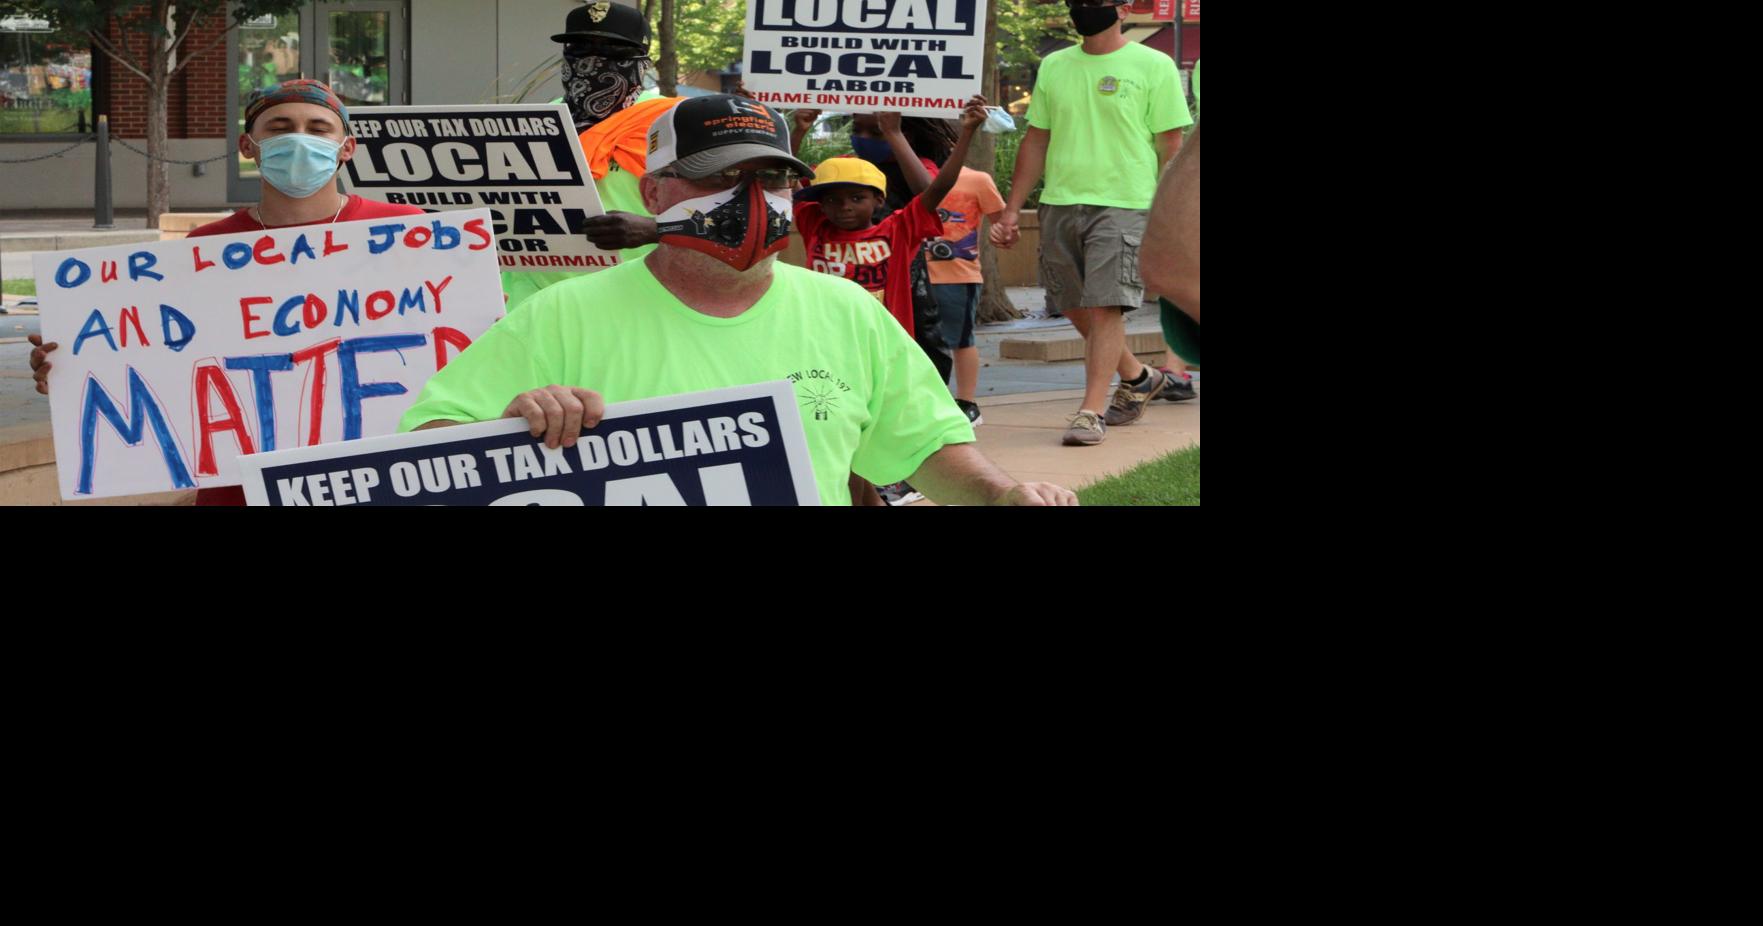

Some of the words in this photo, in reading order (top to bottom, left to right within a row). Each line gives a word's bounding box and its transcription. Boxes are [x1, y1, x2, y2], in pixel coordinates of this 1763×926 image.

[762, 0, 967, 31] LOCAL
[781, 36, 863, 50] BUILD
[870, 38, 946, 52] WITH
[750, 50, 975, 80] LOCAL
[806, 78, 915, 93] LABOR
[817, 93, 841, 105] ON
[843, 94, 879, 106] YOU
[352, 119, 382, 139] EEP
[387, 119, 428, 138] OUR
[428, 119, 469, 138] TAX
[467, 117, 560, 137] DOLLARS
[355, 141, 573, 182] LOCAL
[385, 191, 474, 205] BUILD
[478, 191, 562, 205] WITH
[192, 230, 348, 272] LOCAL
[519, 255, 618, 267] NORMAL!
[825, 240, 891, 265] HARD
[73, 304, 196, 355] AND
[240, 275, 452, 339] ECONOMY
[805, 369, 834, 382] LOCAL
[836, 378, 851, 392] 197
[276, 466, 379, 506] KEEP
[389, 453, 482, 498] OUR
[486, 441, 573, 484] TAX
[576, 411, 770, 472] DOLLARS
